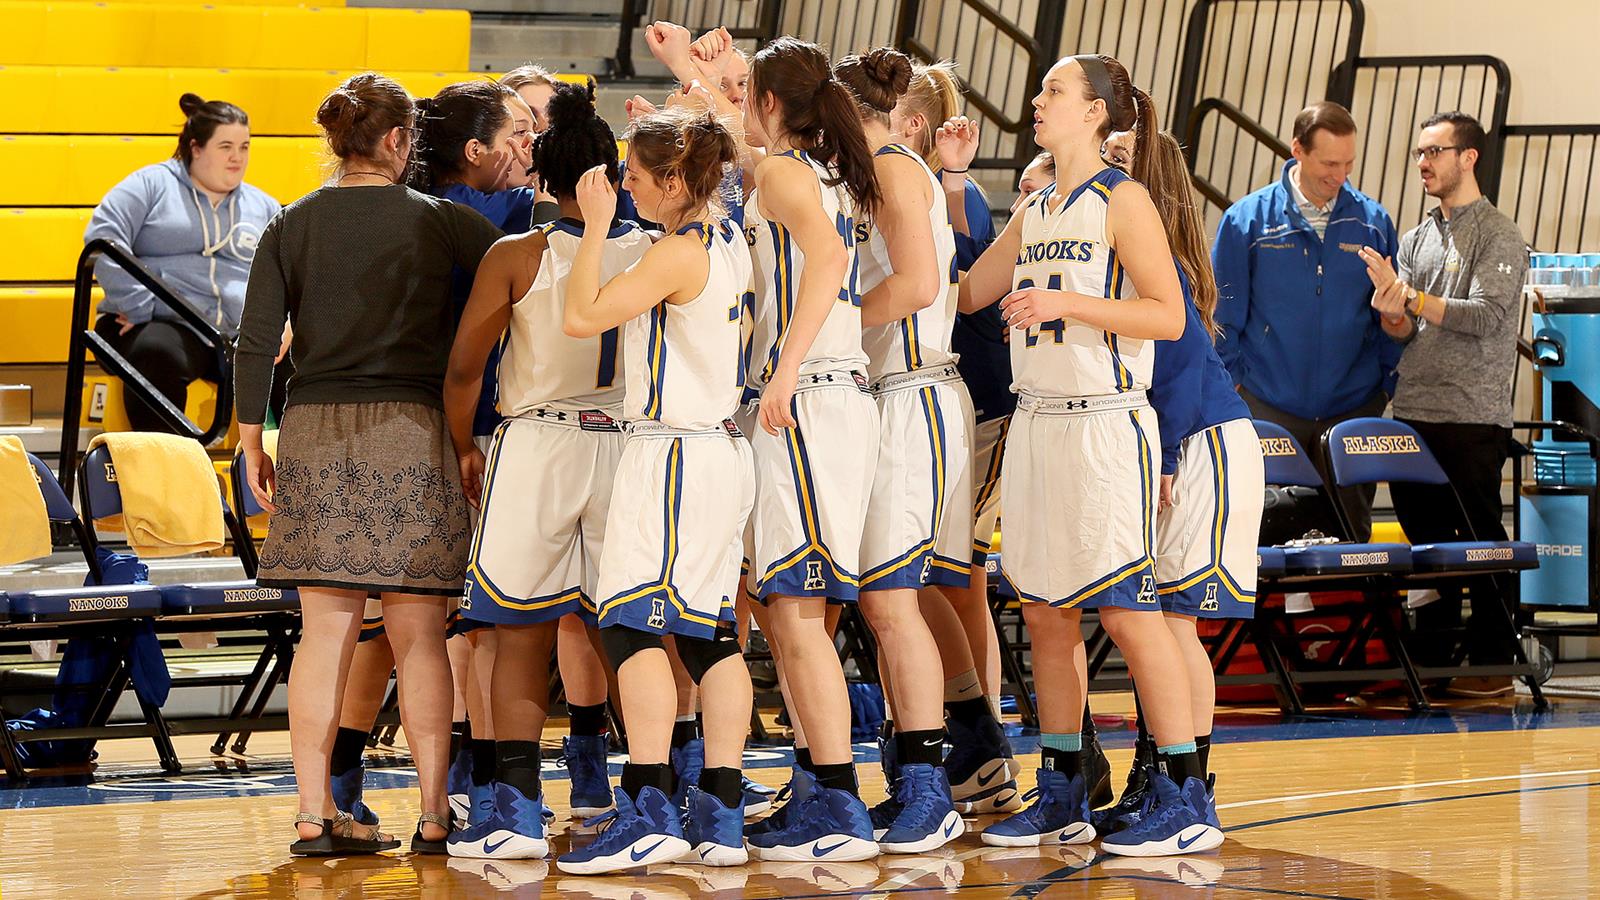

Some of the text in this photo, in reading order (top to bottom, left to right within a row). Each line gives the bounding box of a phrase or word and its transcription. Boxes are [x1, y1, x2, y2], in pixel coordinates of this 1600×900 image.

[1016, 239, 1094, 266] NOOKS
[1343, 435, 1420, 454] ALASKA
[1466, 548, 1514, 561] NANOOKS
[1536, 544, 1583, 556] ERADE
[1341, 552, 1389, 566] NANOOKS
[225, 588, 282, 603] NANOOKS
[69, 596, 129, 612] NANOOKS
